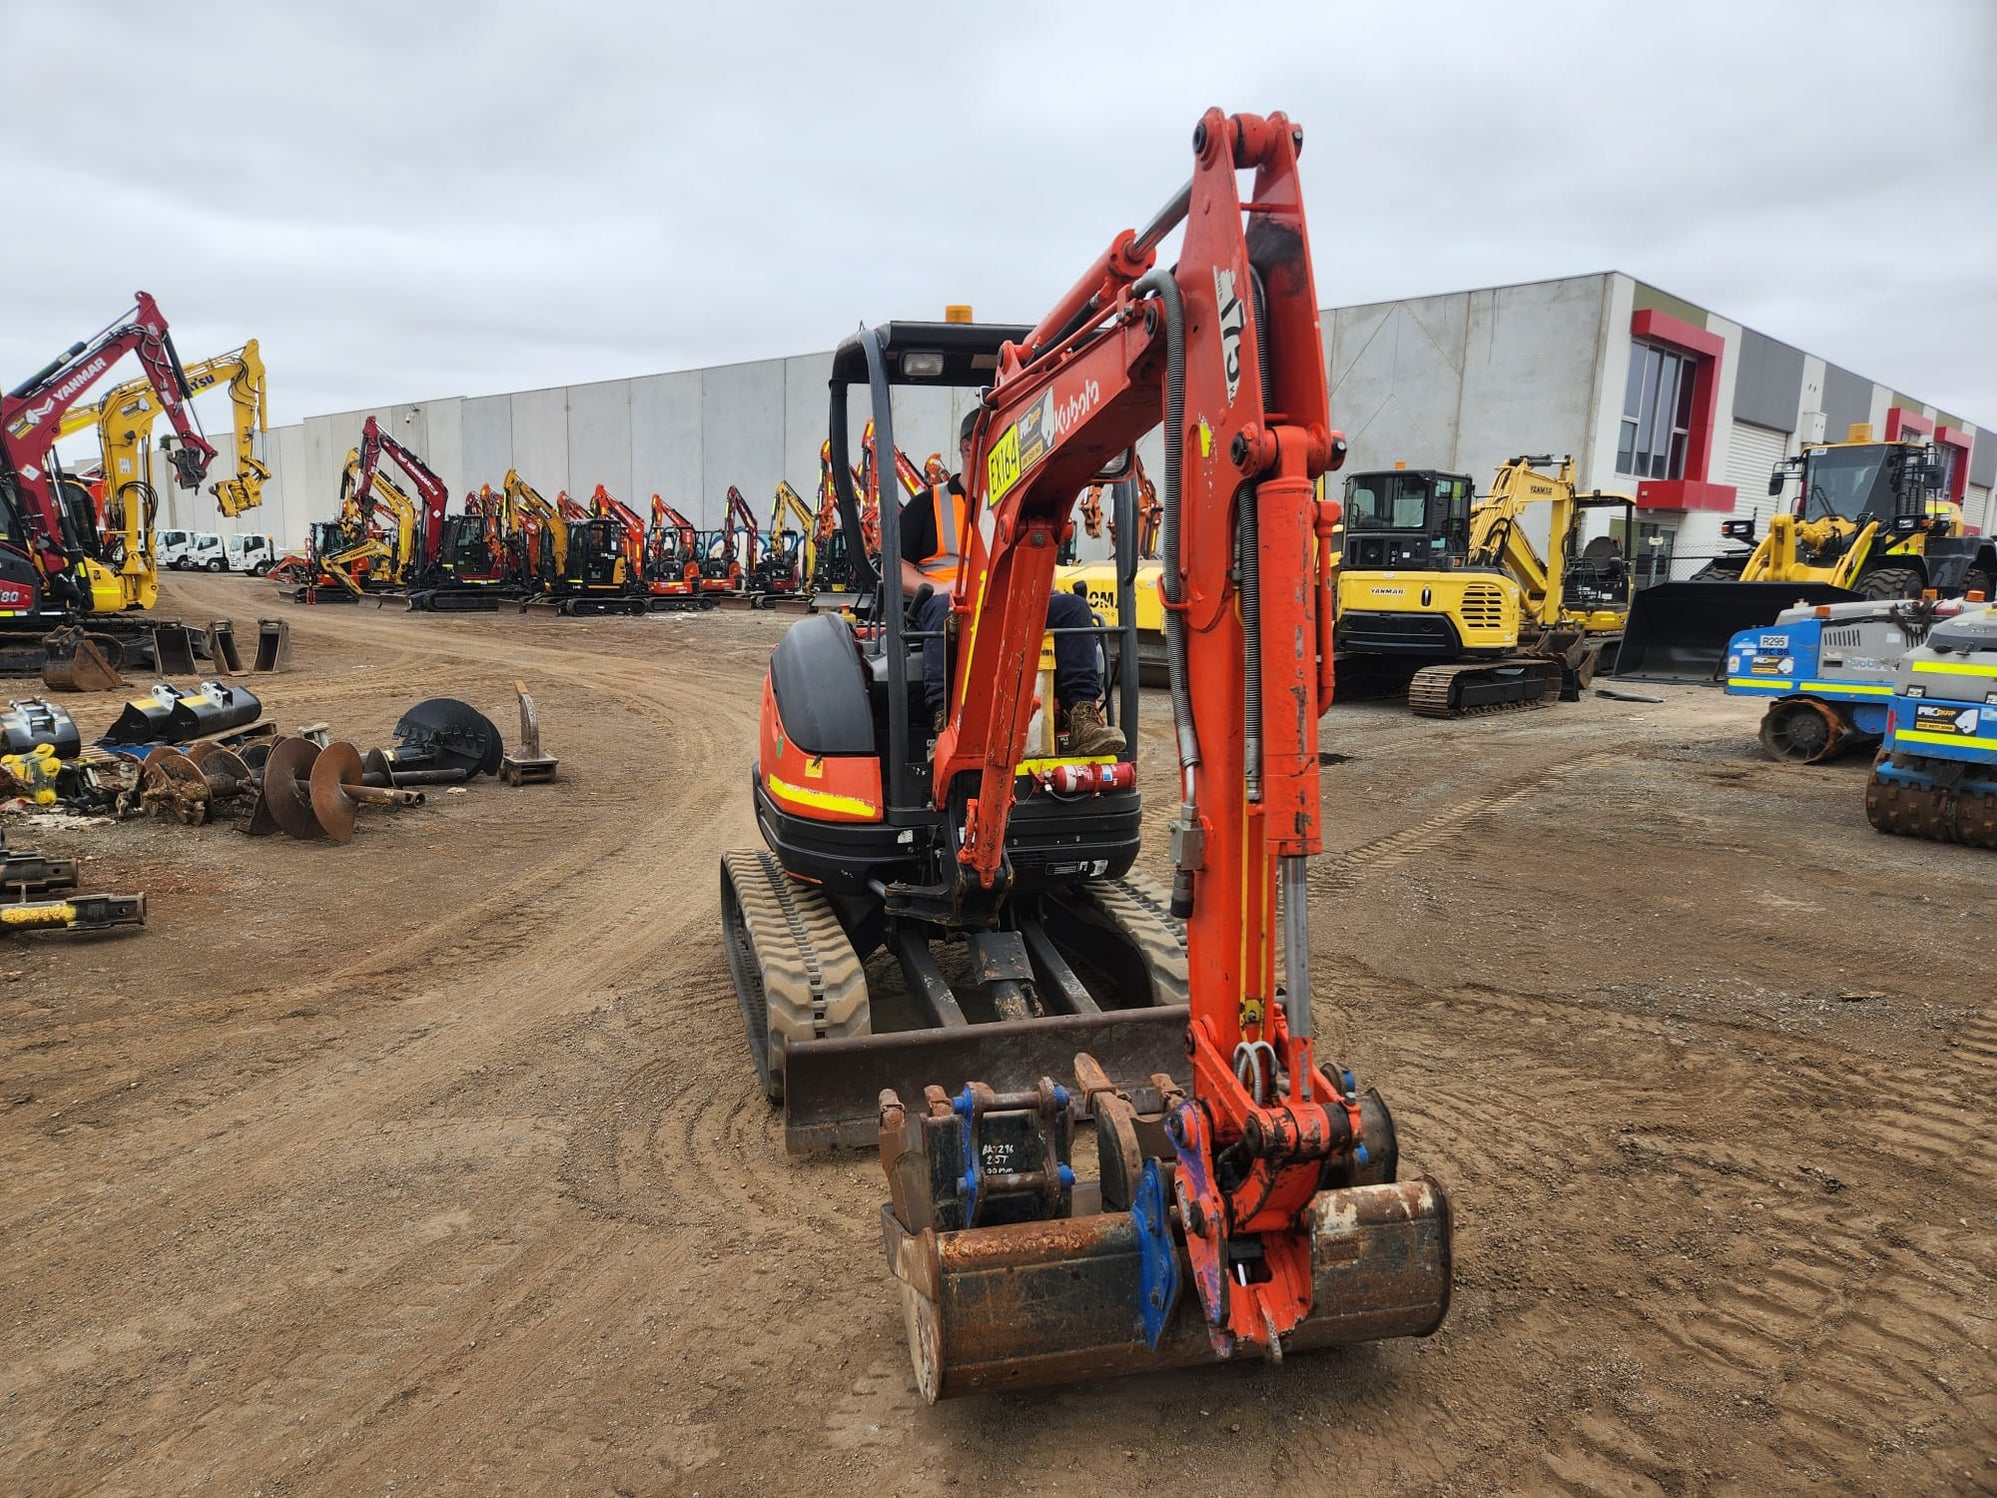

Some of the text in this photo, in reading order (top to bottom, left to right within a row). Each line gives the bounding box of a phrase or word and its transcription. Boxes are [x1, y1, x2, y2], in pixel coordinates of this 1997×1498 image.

[54, 357, 107, 401] YANMAR
[1055, 379, 1100, 434] Kubota
[990, 430, 1018, 495] EX164
[0, 590, 20, 603] 80
[1371, 587, 1404, 595] YANMAR
[1763, 637, 1785, 646] R295
